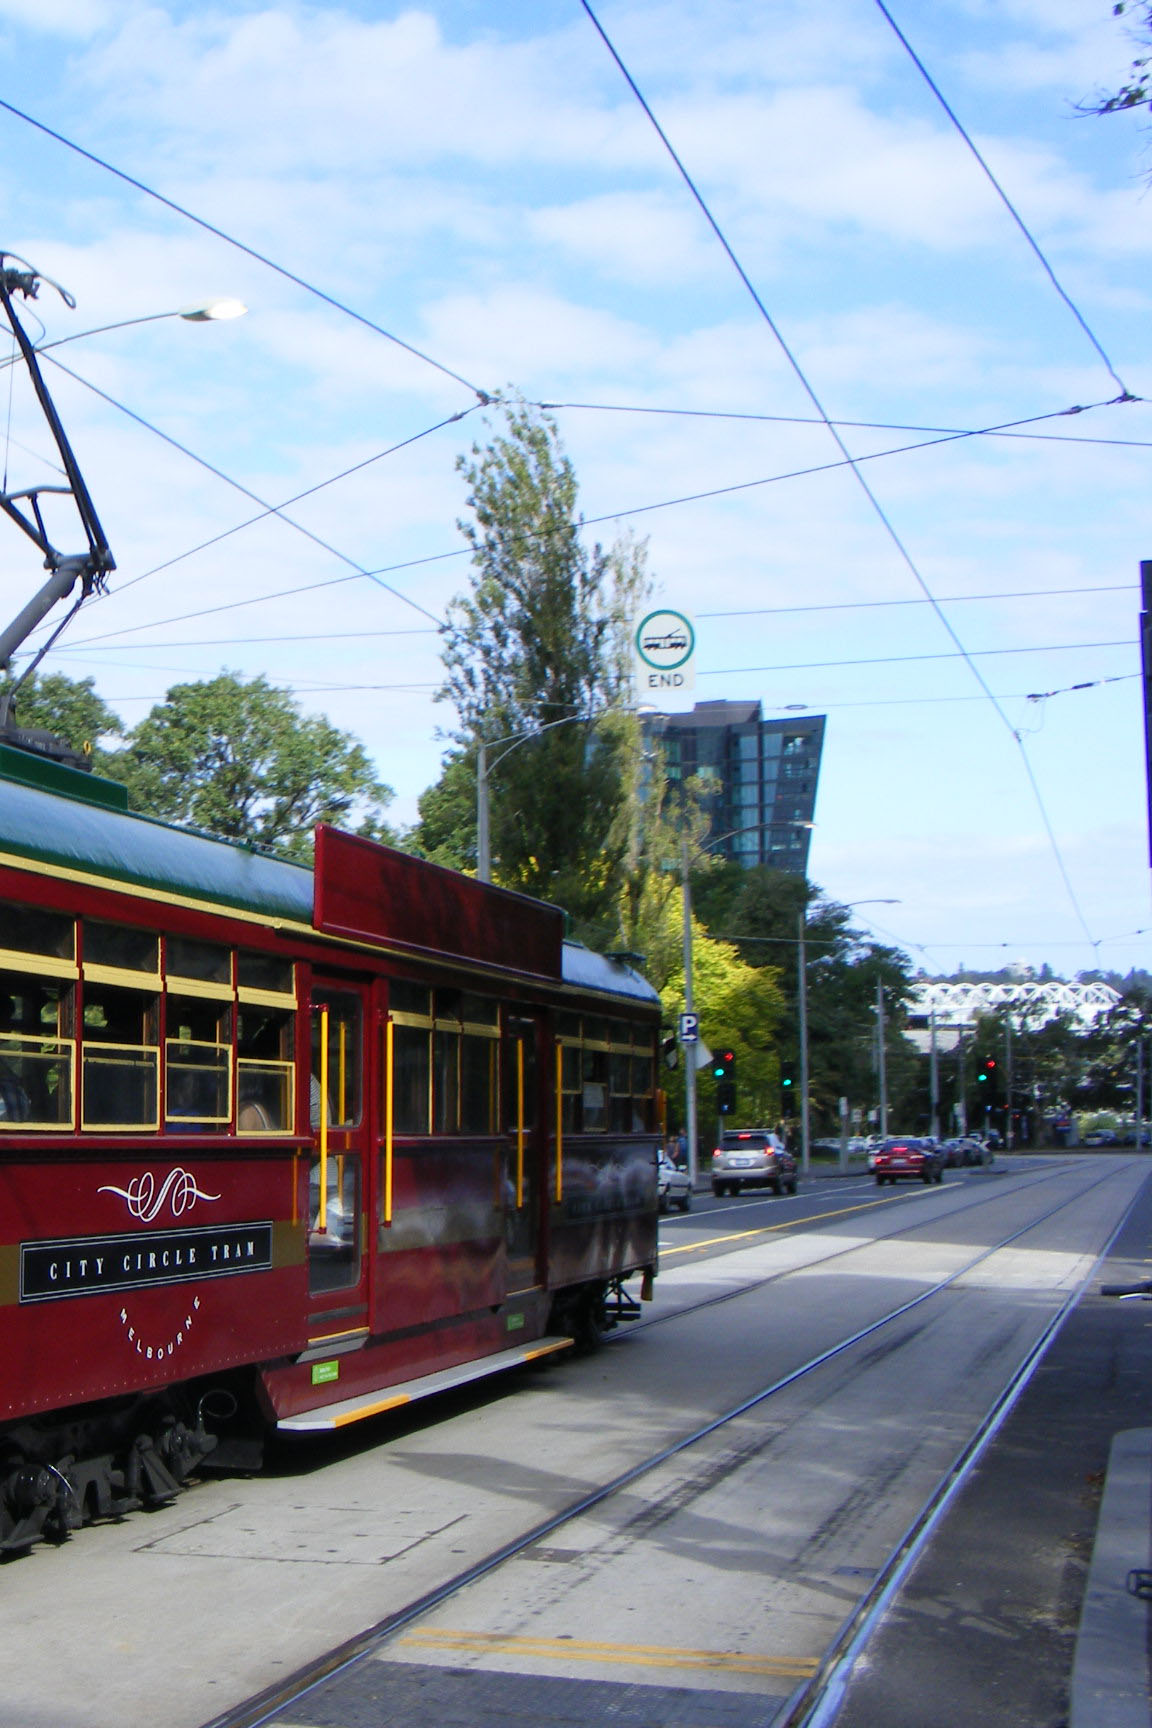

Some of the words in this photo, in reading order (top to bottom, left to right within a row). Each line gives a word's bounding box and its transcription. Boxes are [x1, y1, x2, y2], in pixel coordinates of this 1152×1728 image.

[648, 674, 684, 687] END
[682, 1015, 697, 1034] P
[50, 1258, 104, 1280] CITY
[123, 1248, 196, 1271] CIRCLE
[211, 1242, 254, 1261] TRAM
